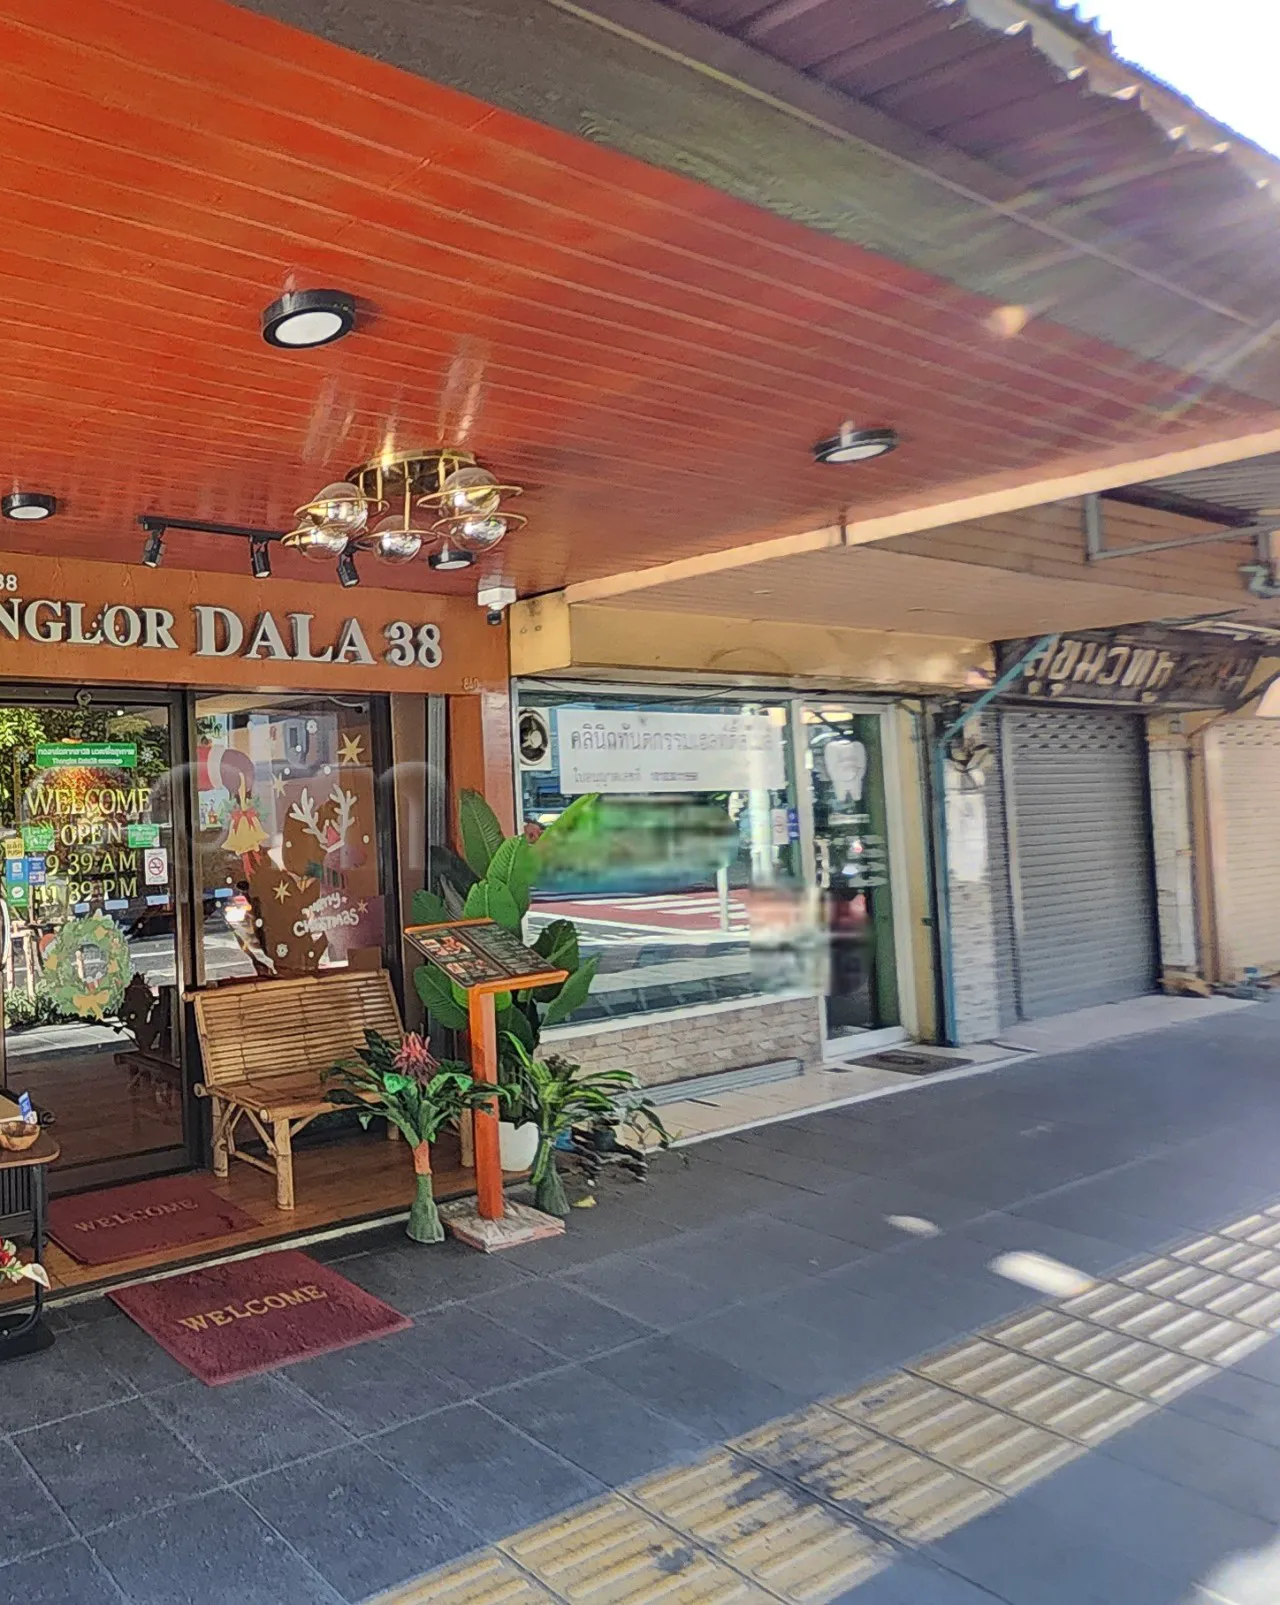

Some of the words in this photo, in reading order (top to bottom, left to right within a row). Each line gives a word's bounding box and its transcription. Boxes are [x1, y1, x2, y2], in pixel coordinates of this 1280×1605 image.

[194, 605, 378, 667] DALA
[384, 620, 443, 669] 38
[26, 787, 153, 816] WELCOME
[60, 822, 122, 846] OPEN
[74, 1199, 198, 1234] WELCOME
[178, 1284, 328, 1333] WELCOME
